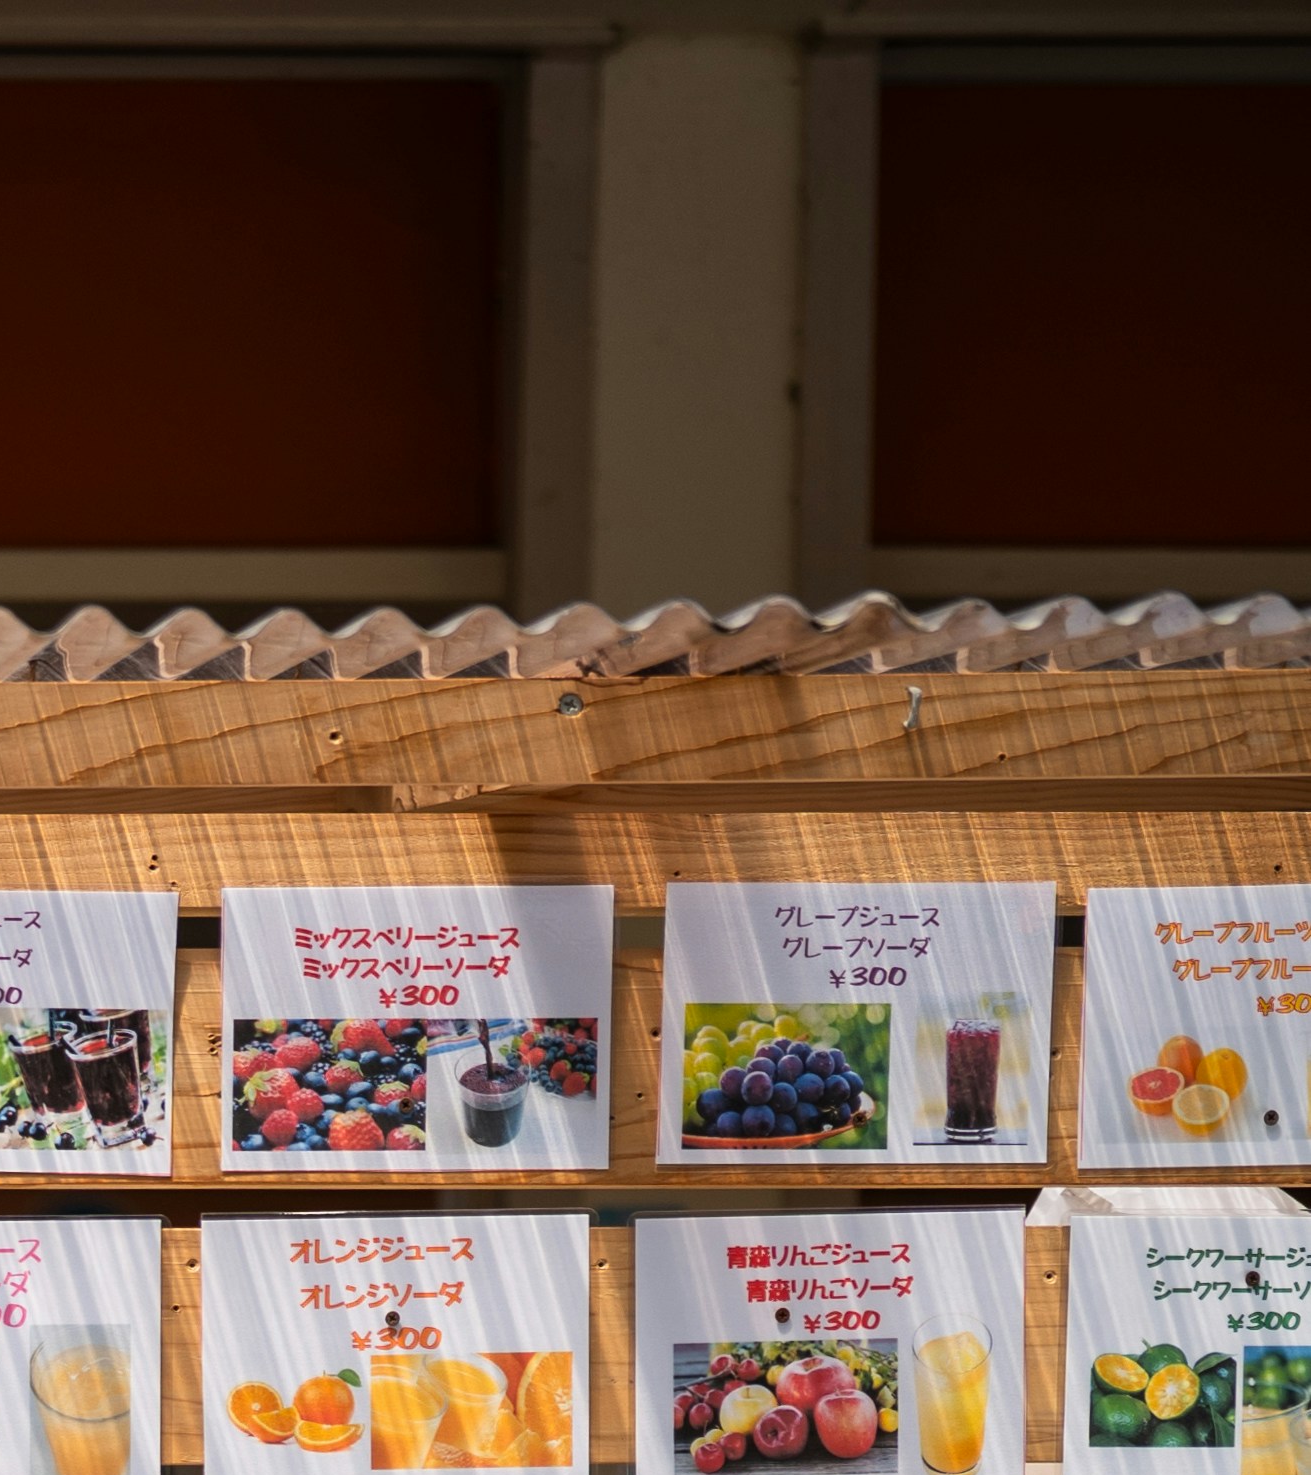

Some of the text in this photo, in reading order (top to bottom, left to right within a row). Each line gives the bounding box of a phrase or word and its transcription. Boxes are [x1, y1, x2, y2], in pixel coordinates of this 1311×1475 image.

[775, 906, 940, 928] グレープジュース
[295, 926, 520, 949] ミックスベリージュース
[783, 936, 931, 959] グレープソーダ
[303, 956, 511, 979] ミックスベリーソーダ
[829, 967, 906, 988] ¥300
[379, 985, 459, 1008] ¥300
[290, 1237, 474, 1264] オレンジジュース
[727, 1243, 911, 1269] 青森りんごジュース
[300, 1281, 465, 1310] オレンジソーダ
[747, 1276, 914, 1303] 青森りんごソーダ
[804, 1310, 880, 1334] ¥300
[352, 1327, 442, 1351] ¥300
